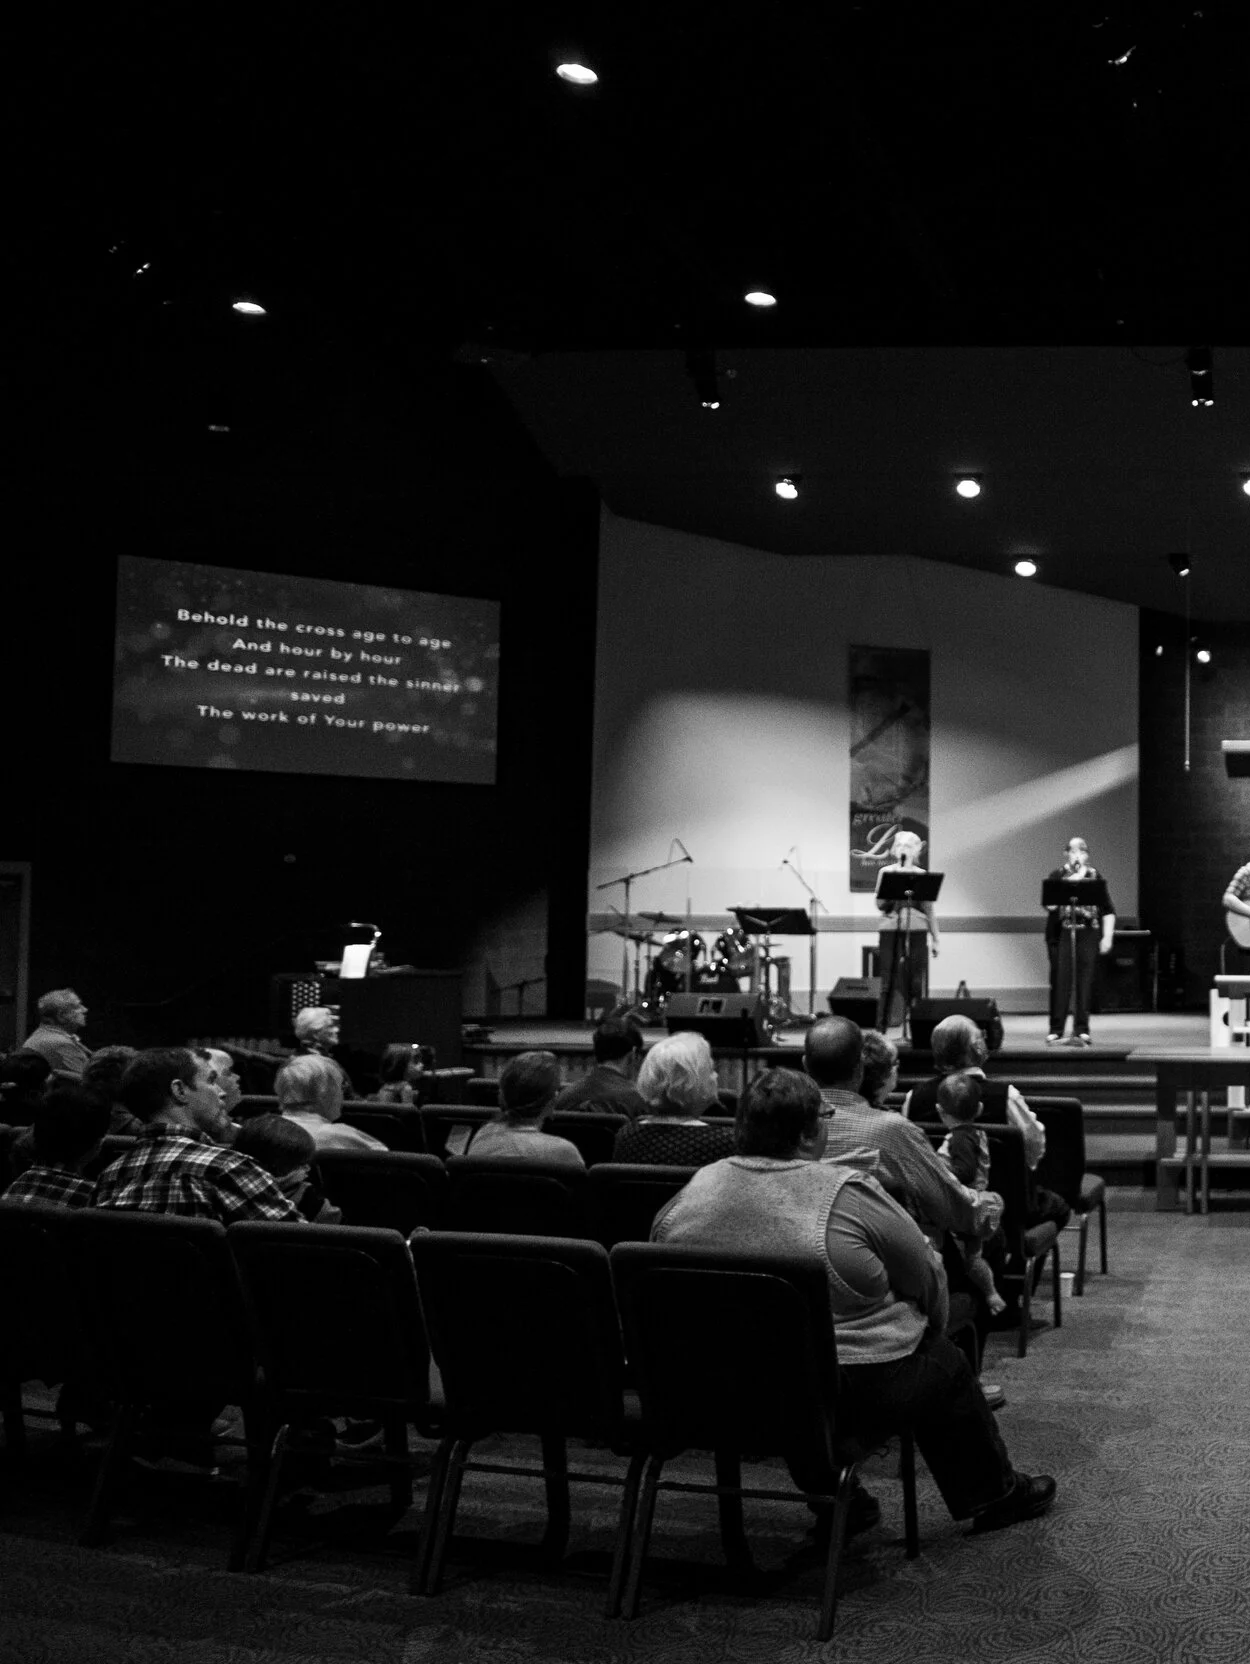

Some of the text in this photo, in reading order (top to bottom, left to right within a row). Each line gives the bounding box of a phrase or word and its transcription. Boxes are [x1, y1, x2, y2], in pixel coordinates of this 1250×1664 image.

[177, 608, 451, 650] Behold the cross age to age
[232, 638, 401, 665] And hour by hour
[161, 655, 460, 694] The dead are raised the sinner
[290, 690, 345, 705] saved
[197, 705, 429, 733] The work of Your power
